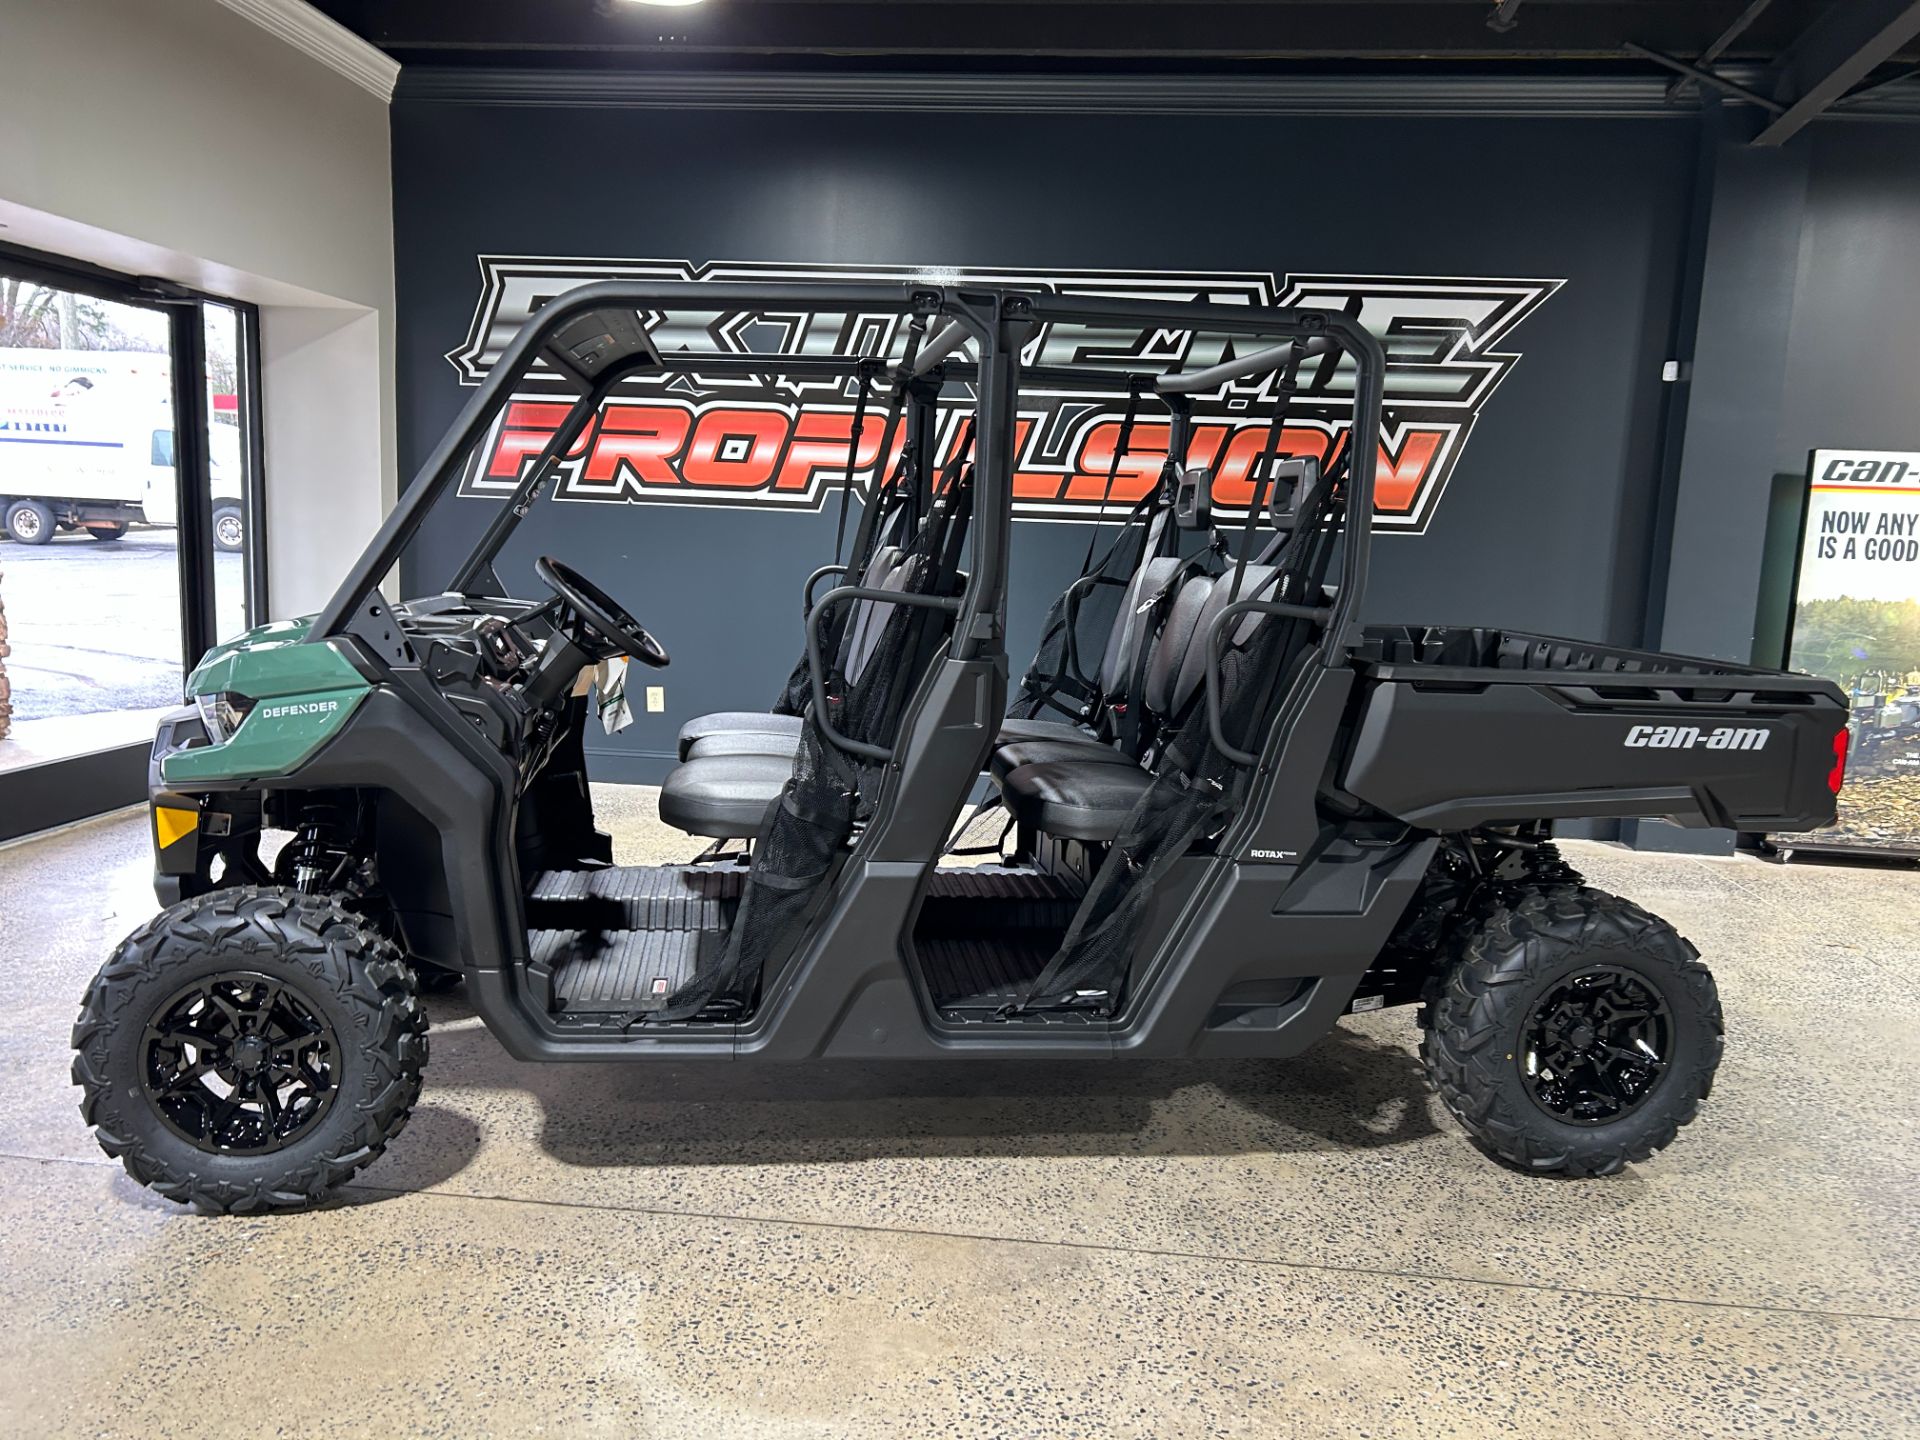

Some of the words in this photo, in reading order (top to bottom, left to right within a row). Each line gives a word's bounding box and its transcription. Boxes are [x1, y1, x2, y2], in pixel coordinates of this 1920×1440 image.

[1822, 459, 1920, 483] can-
[1821, 510, 1870, 534] NOW
[1875, 512, 1919, 536] ANY
[1818, 536, 1838, 559] IS
[1843, 537, 1856, 560] A
[1864, 538, 1919, 562] GOOD
[263, 701, 338, 718] DEFENDER
[1624, 725, 1771, 750] can-am
[1251, 850, 1284, 859] ROTAX
